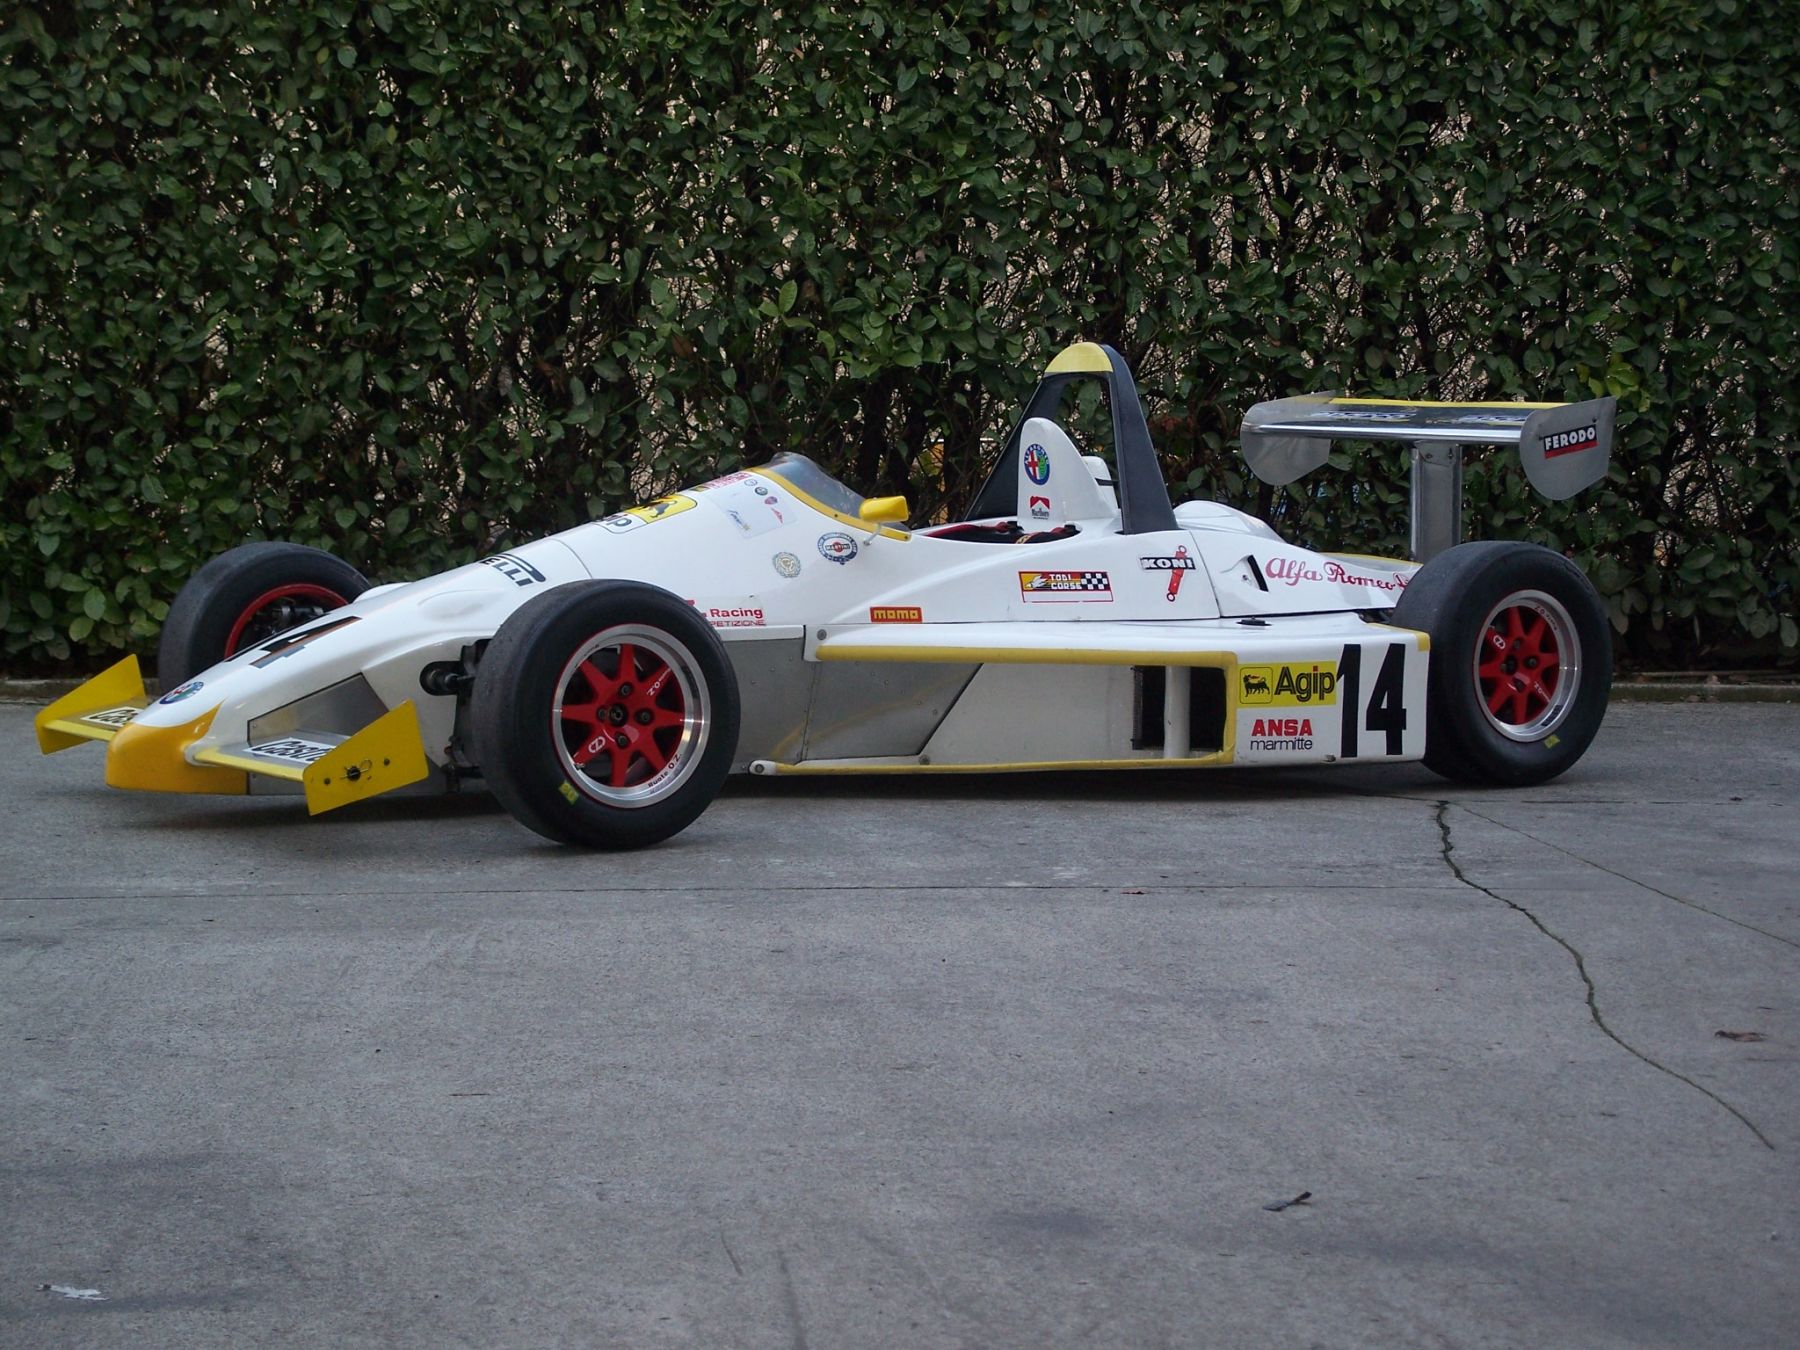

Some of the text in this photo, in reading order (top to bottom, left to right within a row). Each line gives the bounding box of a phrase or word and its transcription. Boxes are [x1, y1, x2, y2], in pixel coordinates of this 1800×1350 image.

[1545, 427, 1595, 450] FERODO
[479, 553, 546, 587] ELLI
[1141, 558, 1195, 569] KONI
[1265, 558, 1323, 586] Alfa
[1324, 561, 1395, 590] Romeo
[710, 608, 763, 618] Racing
[873, 610, 919, 619] momo
[1274, 666, 1335, 702] Agip
[1336, 643, 1406, 758] 14
[1252, 719, 1312, 736] ANSA
[1251, 738, 1312, 751] marmitte
